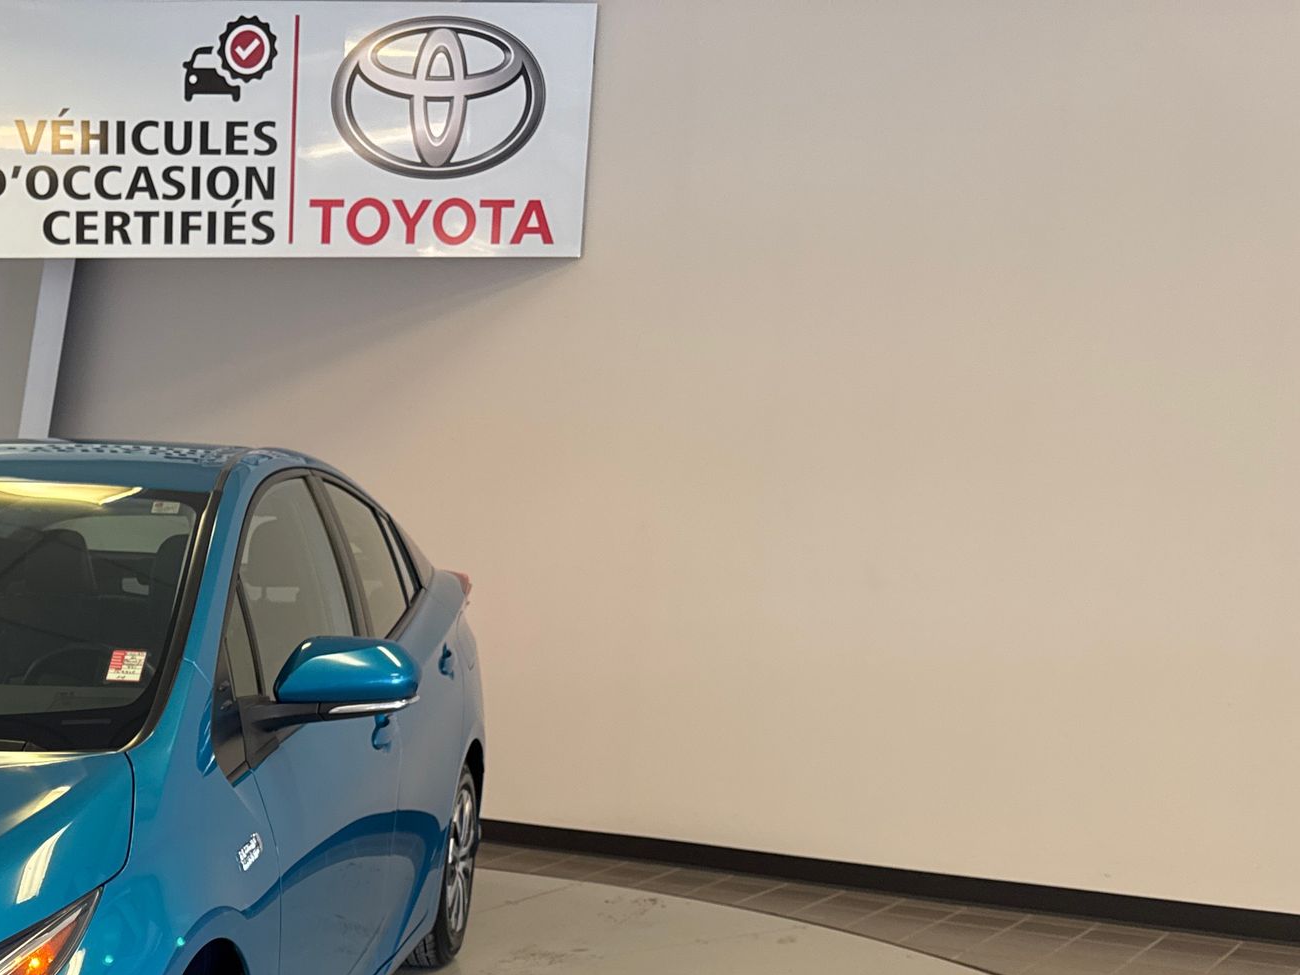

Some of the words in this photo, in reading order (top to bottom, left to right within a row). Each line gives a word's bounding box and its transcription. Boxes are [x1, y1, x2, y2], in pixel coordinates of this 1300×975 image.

[14, 107, 278, 157] VÉHICULES
[43, 200, 276, 246] CERTIFIÉS
[309, 197, 554, 246] TOYOTA
